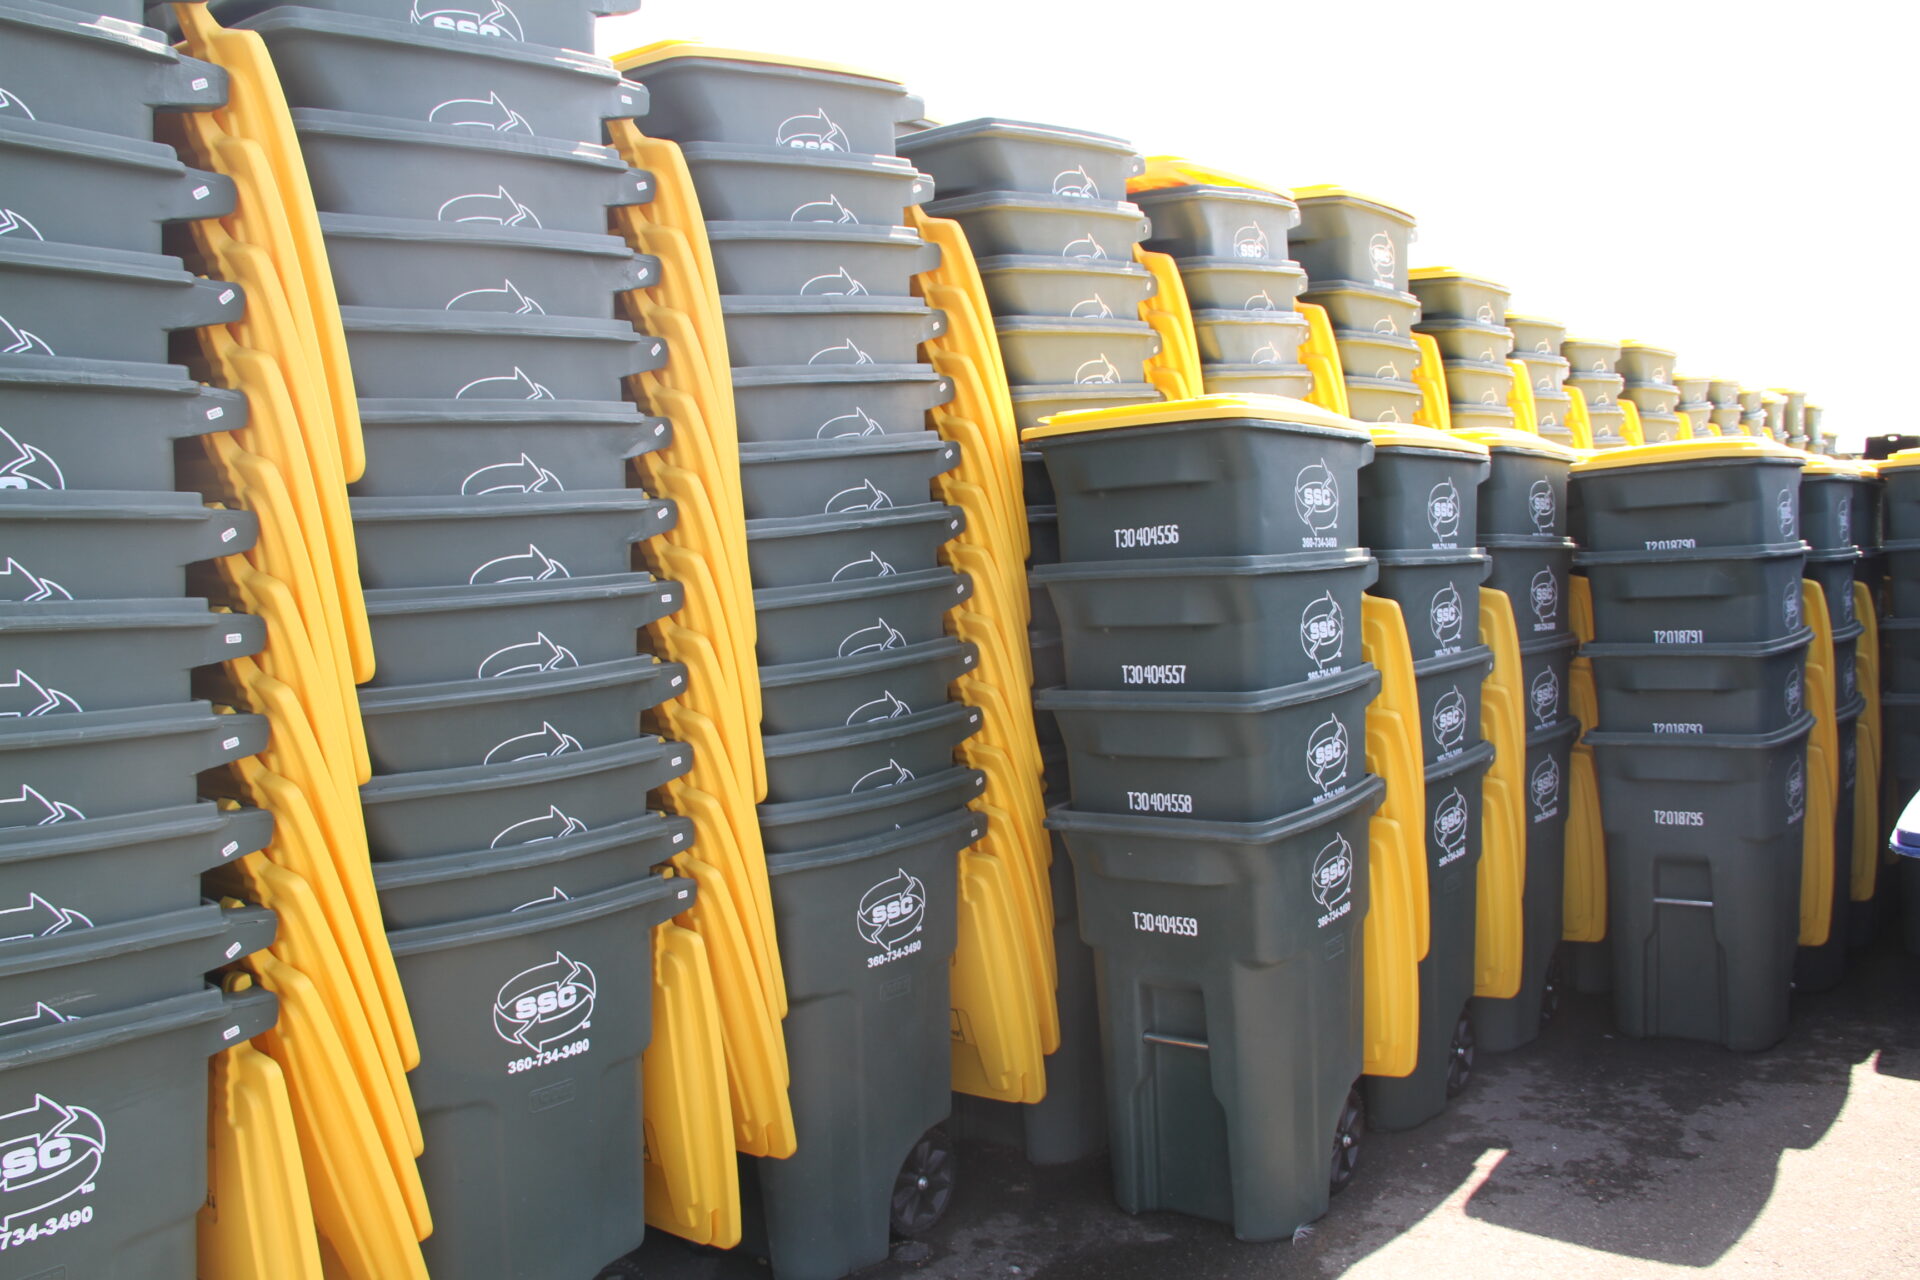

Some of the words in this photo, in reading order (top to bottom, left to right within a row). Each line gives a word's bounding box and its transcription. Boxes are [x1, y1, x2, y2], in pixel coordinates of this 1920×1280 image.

[1304, 487, 1331, 506] SSC
[1434, 502, 1453, 517] SSC
[1114, 524, 1179, 548] T30404556
[1436, 607, 1456, 622] SSC
[1310, 620, 1336, 639] SSC
[1653, 630, 1703, 644] T2018791
[1121, 664, 1186, 684] T30404557
[1440, 710, 1459, 728] SSC
[1315, 741, 1341, 764] SSC
[1127, 791, 1193, 813] T30404558
[1441, 809, 1461, 831] SSC
[1653, 809, 1704, 826] T2018795
[1321, 859, 1346, 885] SSC
[872, 896, 914, 923] SSC
[1132, 911, 1199, 936] T30404559
[867, 939, 922, 968] 360-734-3490
[515, 985, 577, 1019] SSC
[507, 1038, 590, 1074] 360-734-3490
[0, 1137, 72, 1179] SC
